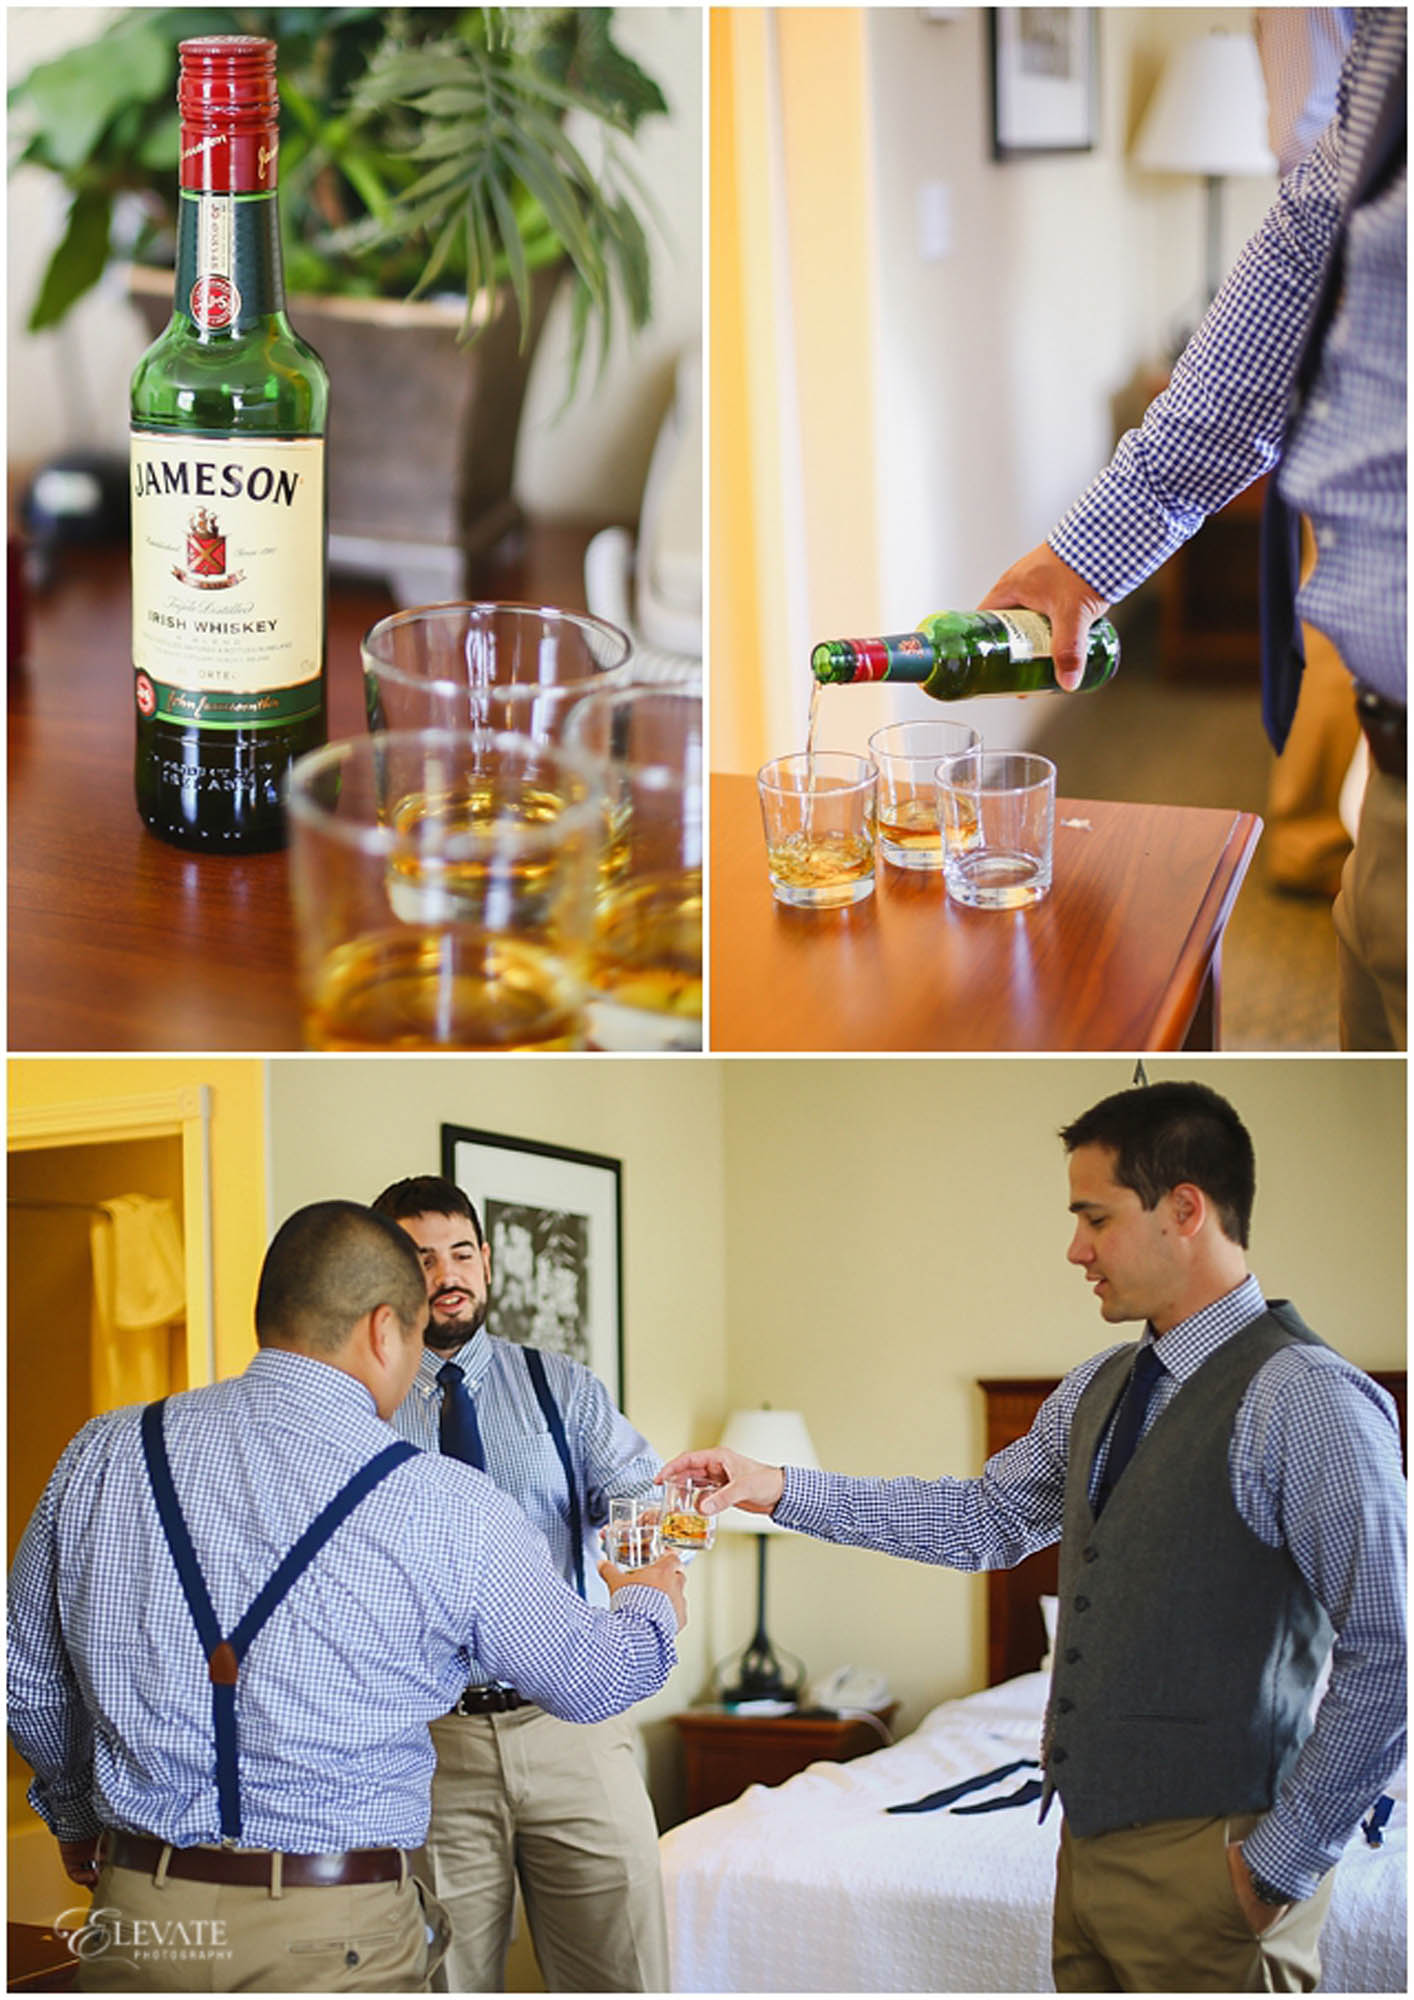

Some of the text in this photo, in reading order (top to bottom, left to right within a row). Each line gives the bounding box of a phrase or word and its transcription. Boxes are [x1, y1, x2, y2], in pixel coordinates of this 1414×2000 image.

[135, 460, 300, 507] JAMESON
[147, 610, 280, 635] IRISH WHISKEY
